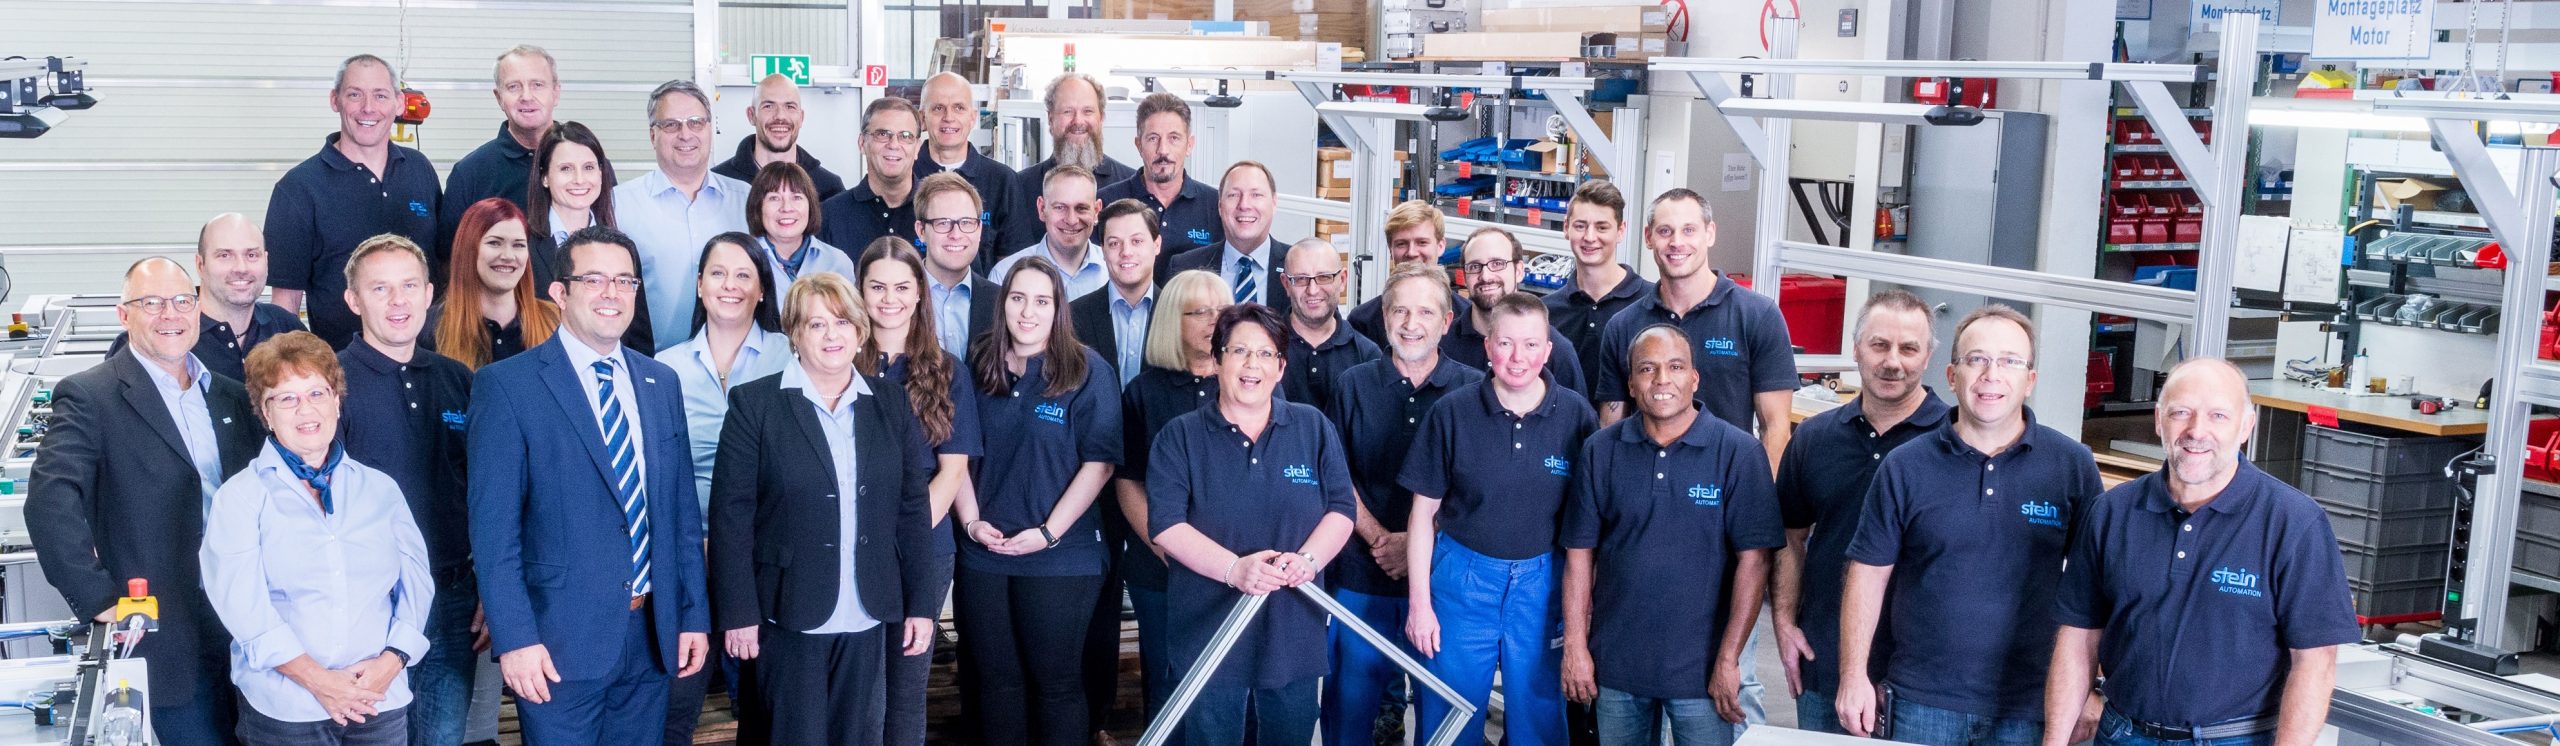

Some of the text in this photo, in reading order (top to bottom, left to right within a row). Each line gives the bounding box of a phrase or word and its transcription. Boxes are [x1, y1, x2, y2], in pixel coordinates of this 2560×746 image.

[2328, 0, 2422, 20] Montageplatz
[2350, 25, 2390, 45] Motor
[1705, 337, 1734, 350] stein
[1034, 402, 1065, 418] stein
[1038, 414, 1064, 425] AUTOMATIO
[2021, 500, 2058, 519] stein
[2211, 566, 2256, 588] stein
[2218, 585, 2262, 598] AUTOMATION
